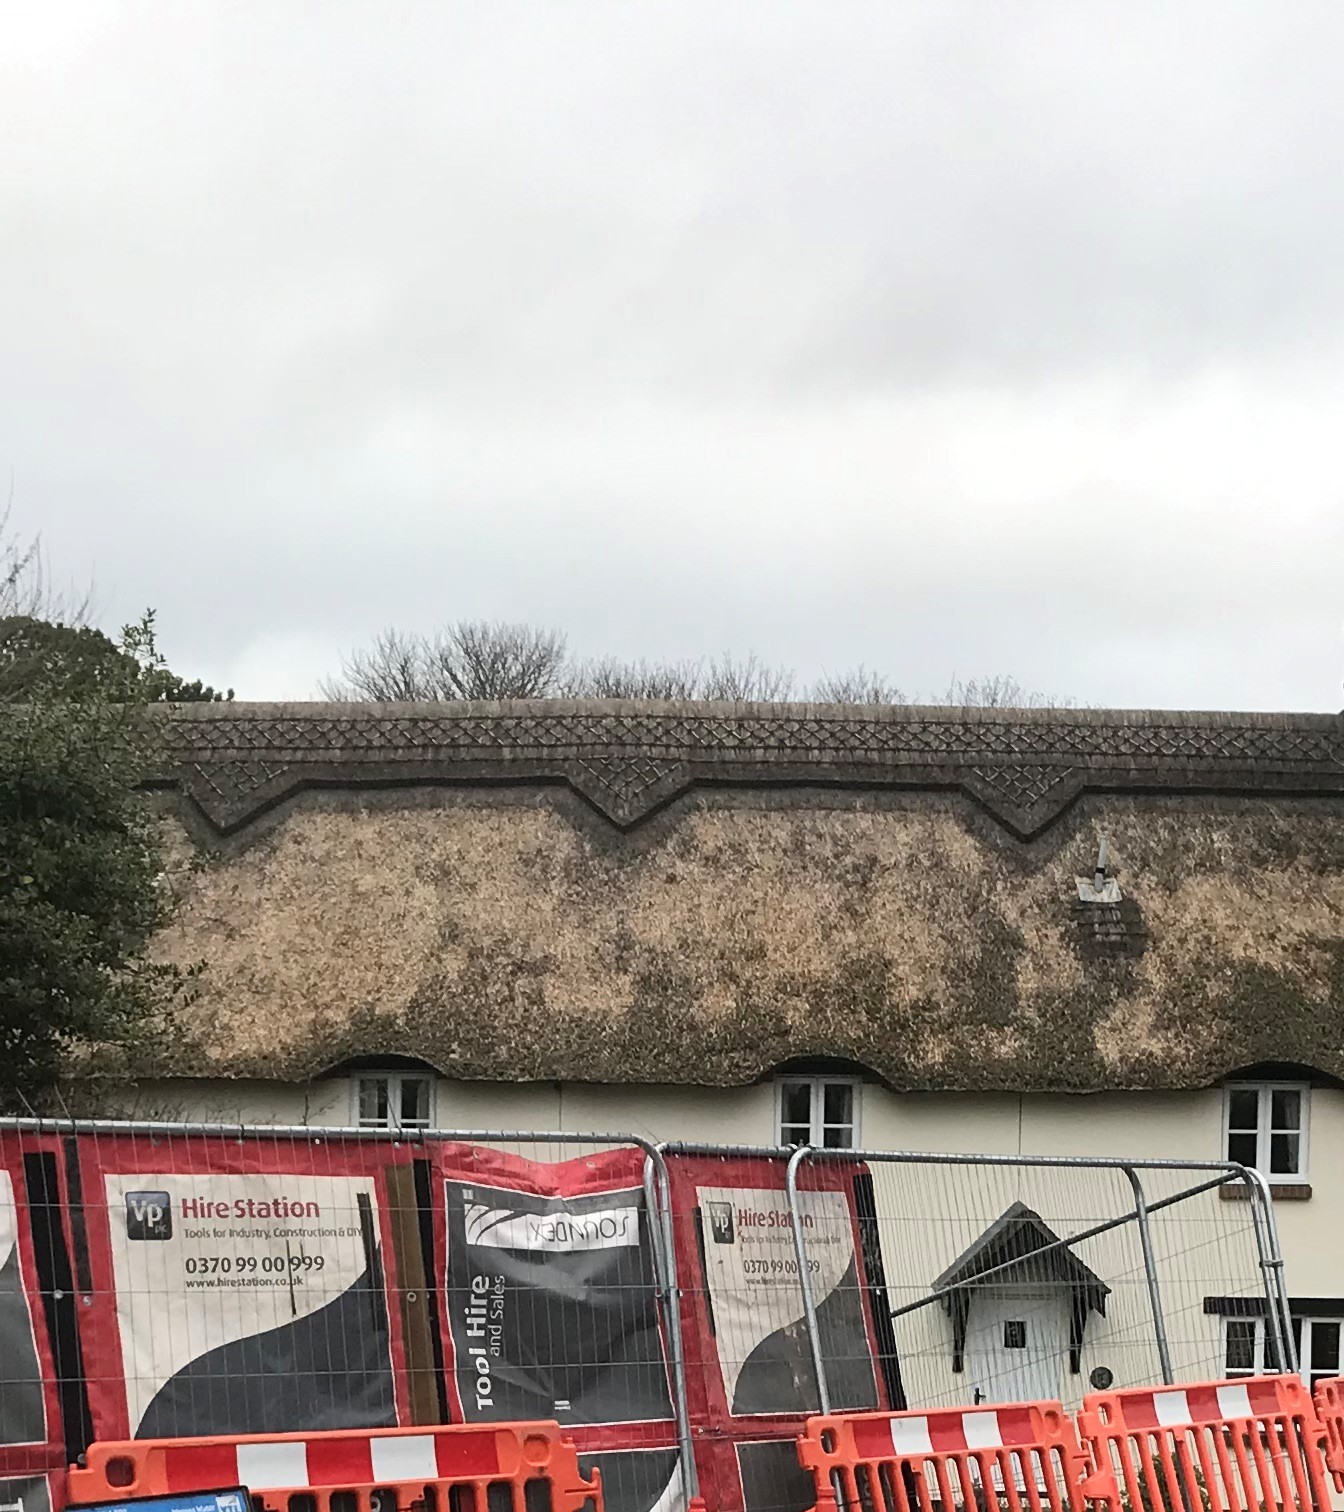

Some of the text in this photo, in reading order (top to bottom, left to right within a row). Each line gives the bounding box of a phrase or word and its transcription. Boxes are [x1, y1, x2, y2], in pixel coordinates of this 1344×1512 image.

[182, 1196, 320, 1219] Hire Station
[738, 1208, 766, 1227] Hire
[185, 1227, 211, 1239] Tools
[213, 1228, 227, 1238] for
[274, 1227, 336, 1238] Construction
[530, 1216, 630, 1242] SOUNDEX
[186, 1255, 324, 1274] 0370 99 00 999
[744, 1259, 820, 1274] 0370 99 00 99
[186, 1275, 304, 1288] www.hirestation.co.uk
[488, 1275, 505, 1357] and Sales
[464, 1275, 494, 1411] Tool Hire
